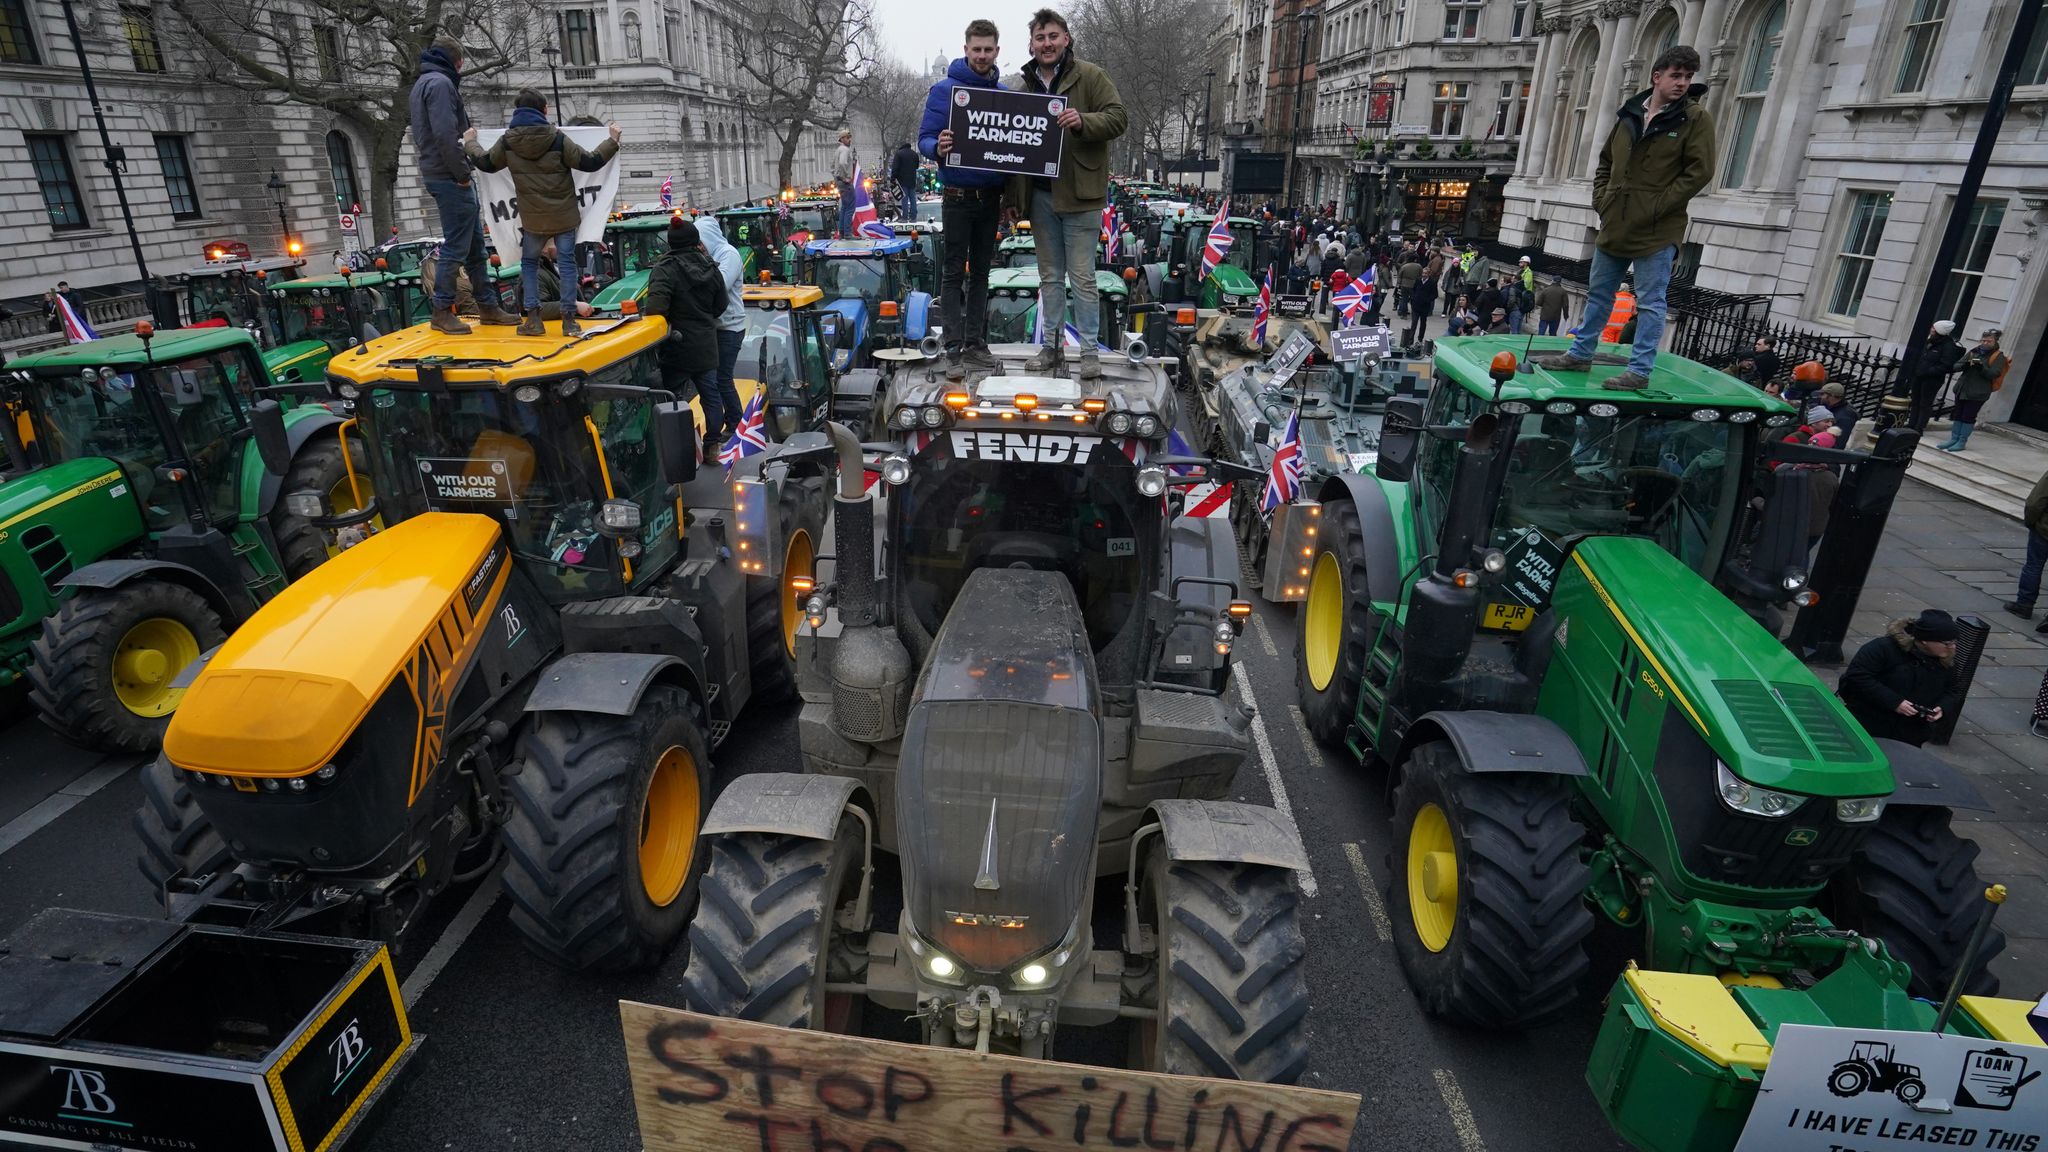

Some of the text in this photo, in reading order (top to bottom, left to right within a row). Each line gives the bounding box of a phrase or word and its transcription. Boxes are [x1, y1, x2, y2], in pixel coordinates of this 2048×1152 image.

[967, 109, 1048, 131] WITH OUR
[968, 126, 1043, 146] FARMERS
[983, 151, 1025, 163] #together
[353, 204, 360, 213] A
[1342, 341, 1380, 350] FARMERS
[813, 400, 829, 423] JCB
[950, 431, 1103, 465] FENDT
[77, 476, 113, 496] JOHN DEERE
[432, 474, 496, 487] WITH OUR
[437, 486, 497, 498] FARMERS
[645, 506, 673, 544] JCB
[1111, 541, 1131, 553] 041
[471, 549, 496, 590] FASTRAC
[1524, 548, 1555, 577] WITH
[1515, 558, 1551, 593] FARME
[1514, 581, 1542, 605] #together
[1495, 605, 1526, 619] RJR
[944, 910, 1030, 928] FENDT
[1975, 1055, 2014, 1072] LOAN
[8, 1115, 197, 1150] GROWING IN ALL FIELDS
[1787, 1108, 2041, 1152] I HAVE LEASED THIS
